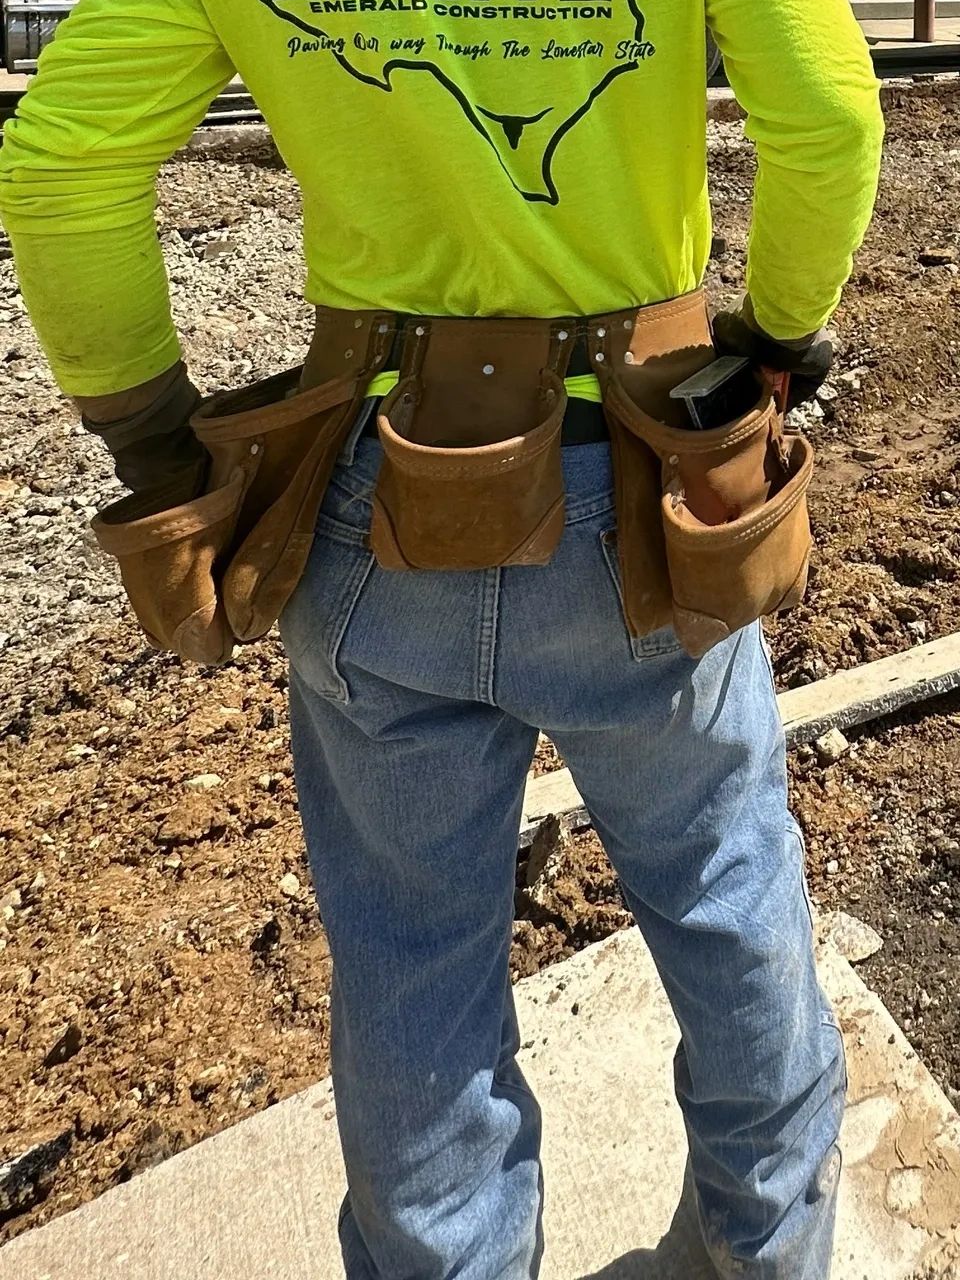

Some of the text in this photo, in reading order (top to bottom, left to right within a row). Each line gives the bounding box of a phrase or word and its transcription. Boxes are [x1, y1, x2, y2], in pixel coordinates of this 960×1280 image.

[433, 3, 612, 19] CONSTRUCTION
[288, 36, 346, 57] Paving
[354, 32, 379, 53] Our
[390, 37, 426, 55] way
[502, 40, 531, 60] The
[541, 39, 604, 60] Lonestar
[615, 40, 656, 61] State
